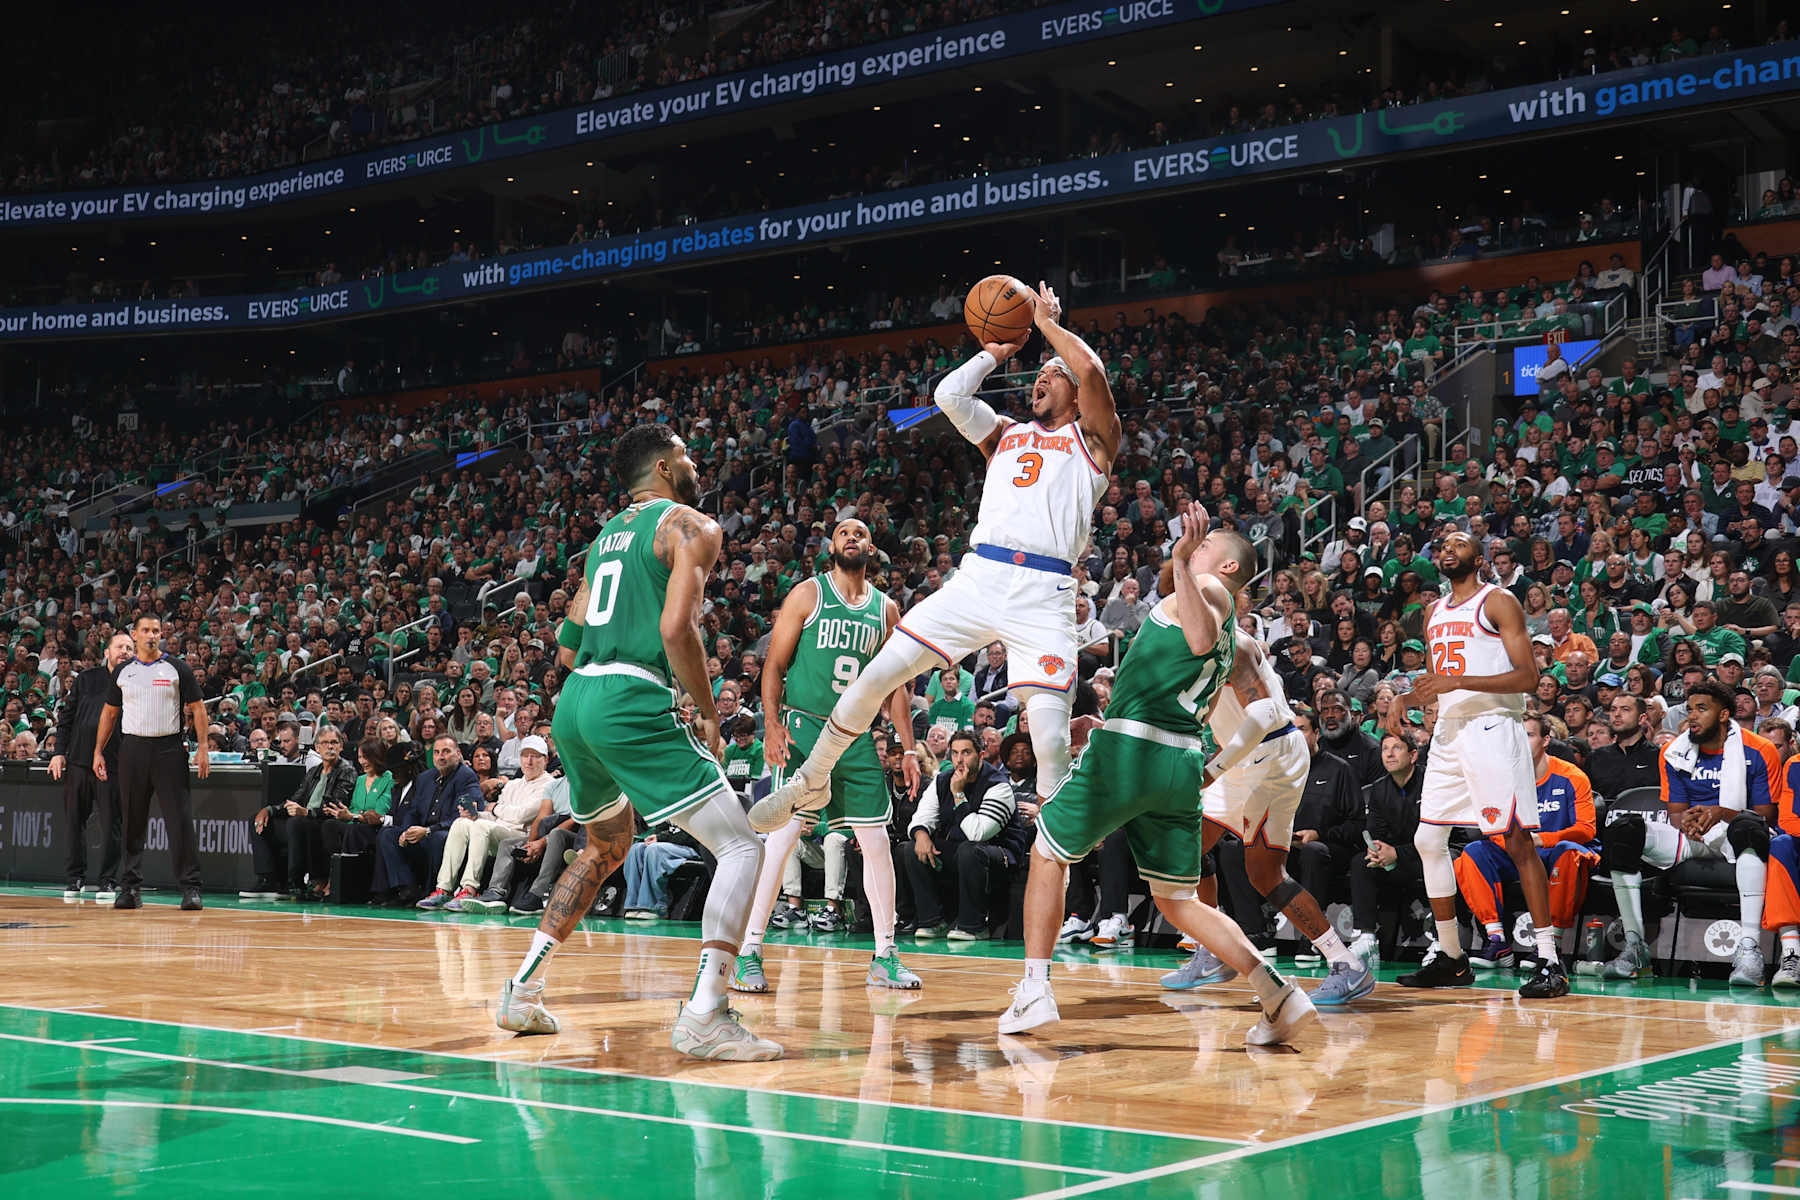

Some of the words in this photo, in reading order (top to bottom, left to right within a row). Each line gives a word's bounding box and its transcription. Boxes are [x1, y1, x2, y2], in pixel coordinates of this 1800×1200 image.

[1041, 0, 1174, 40] EVERSOURCE
[576, 102, 654, 135] Elevate
[659, 90, 711, 123] your
[715, 79, 745, 106] EV
[750, 61, 856, 98] charging
[862, 30, 1006, 76] experience
[1508, 87, 1586, 123] with
[1595, 56, 1800, 115] game-chan
[366, 146, 453, 178] EVERSOURCE
[1133, 135, 1298, 183] EVERSOURCE
[71, 198, 119, 220] your
[123, 192, 150, 212] EV
[154, 186, 246, 212] charging
[249, 167, 344, 204] experience
[463, 262, 505, 288] with
[509, 239, 667, 285] game-changing
[672, 224, 755, 255] rebates
[759, 217, 793, 241] for
[797, 209, 852, 240] your
[856, 198, 925, 226] home
[930, 184, 978, 215] and
[984, 169, 1110, 206] business.
[32, 311, 87, 331] home
[91, 307, 129, 327] and
[134, 303, 230, 325] business.
[247, 290, 349, 319] EVERSOURCE
[998, 431, 1035, 455] NEW
[1032, 430, 1074, 455] YORK
[1012, 452, 1044, 488] 3
[598, 530, 636, 557] TATUM
[584, 559, 623, 627] 0
[816, 618, 881, 659] BOSTON
[832, 654, 860, 694] 9
[1433, 641, 1466, 677] 25
[12, 811, 42, 847] NOV
[43, 812, 53, 848] 5
